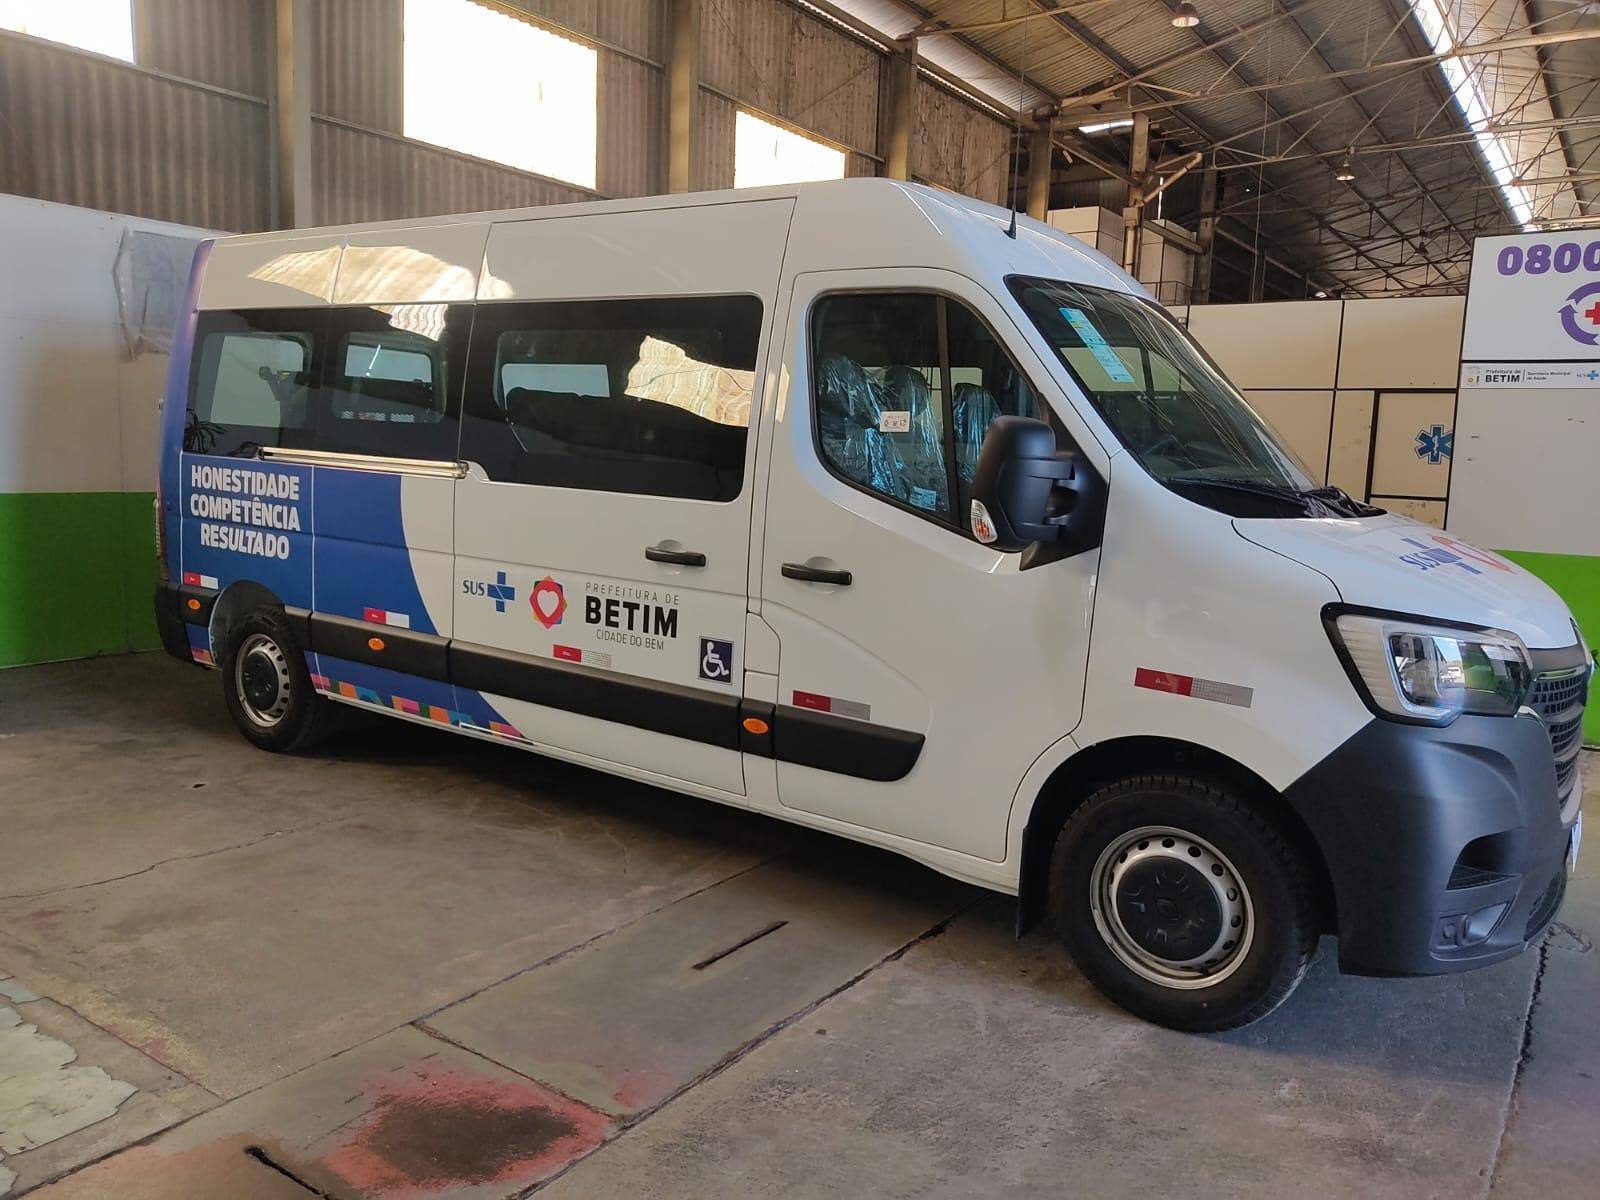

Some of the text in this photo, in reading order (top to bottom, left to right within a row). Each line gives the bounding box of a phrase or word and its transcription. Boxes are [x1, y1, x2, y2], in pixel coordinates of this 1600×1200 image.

[1498, 241, 1600, 276] 0800
[1485, 375, 1520, 383] BETIM
[191, 464, 299, 501] HONESTIDADE
[190, 493, 301, 532] COMPETÊNCIA
[200, 523, 290, 560] RESULTADO
[463, 580, 485, 596] SUS
[585, 582, 679, 605] PREFEITURA DE
[585, 595, 678, 639] BETIM
[596, 629, 664, 651] CIDADE DO BEM
